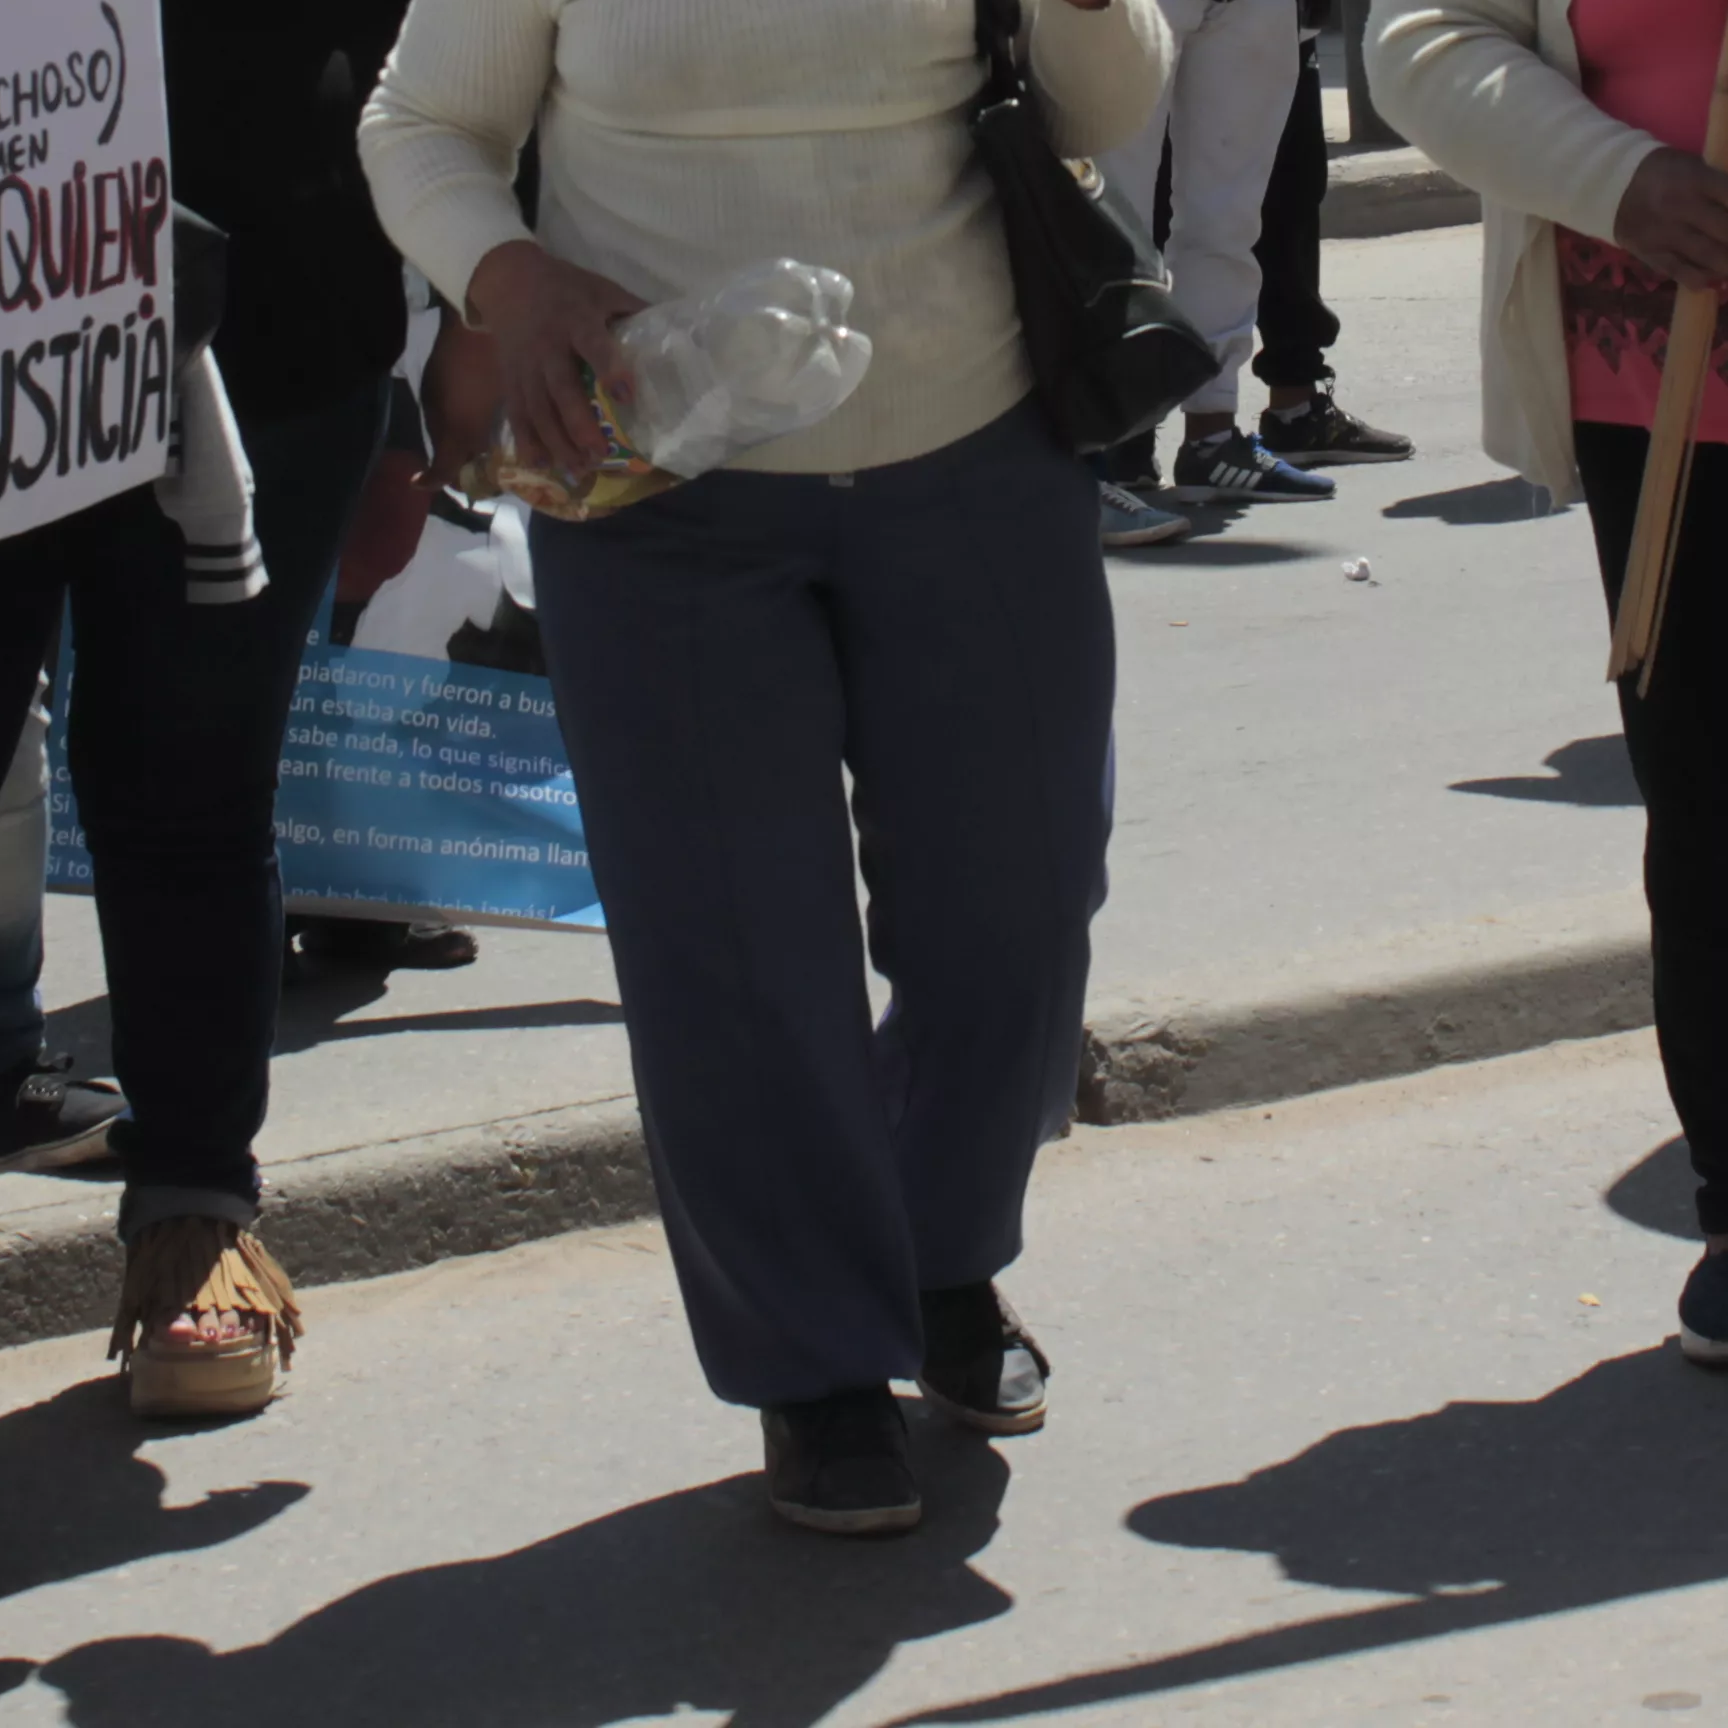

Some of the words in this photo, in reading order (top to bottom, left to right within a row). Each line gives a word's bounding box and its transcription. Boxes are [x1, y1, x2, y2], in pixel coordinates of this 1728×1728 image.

[403, 676, 416, 697] y
[421, 674, 493, 706] fueron
[498, 693, 512, 710] a
[321, 698, 394, 721] estaba
[400, 709, 439, 729] con
[446, 714, 496, 739] vida.
[288, 725, 338, 748] sabe
[412, 737, 432, 759] lo
[439, 747, 481, 765] que
[326, 758, 392, 786] frente
[398, 771, 411, 788] a
[419, 770, 483, 794] todos
[333, 828, 360, 845] en
[368, 825, 432, 854] forma
[440, 837, 540, 863] anónima
